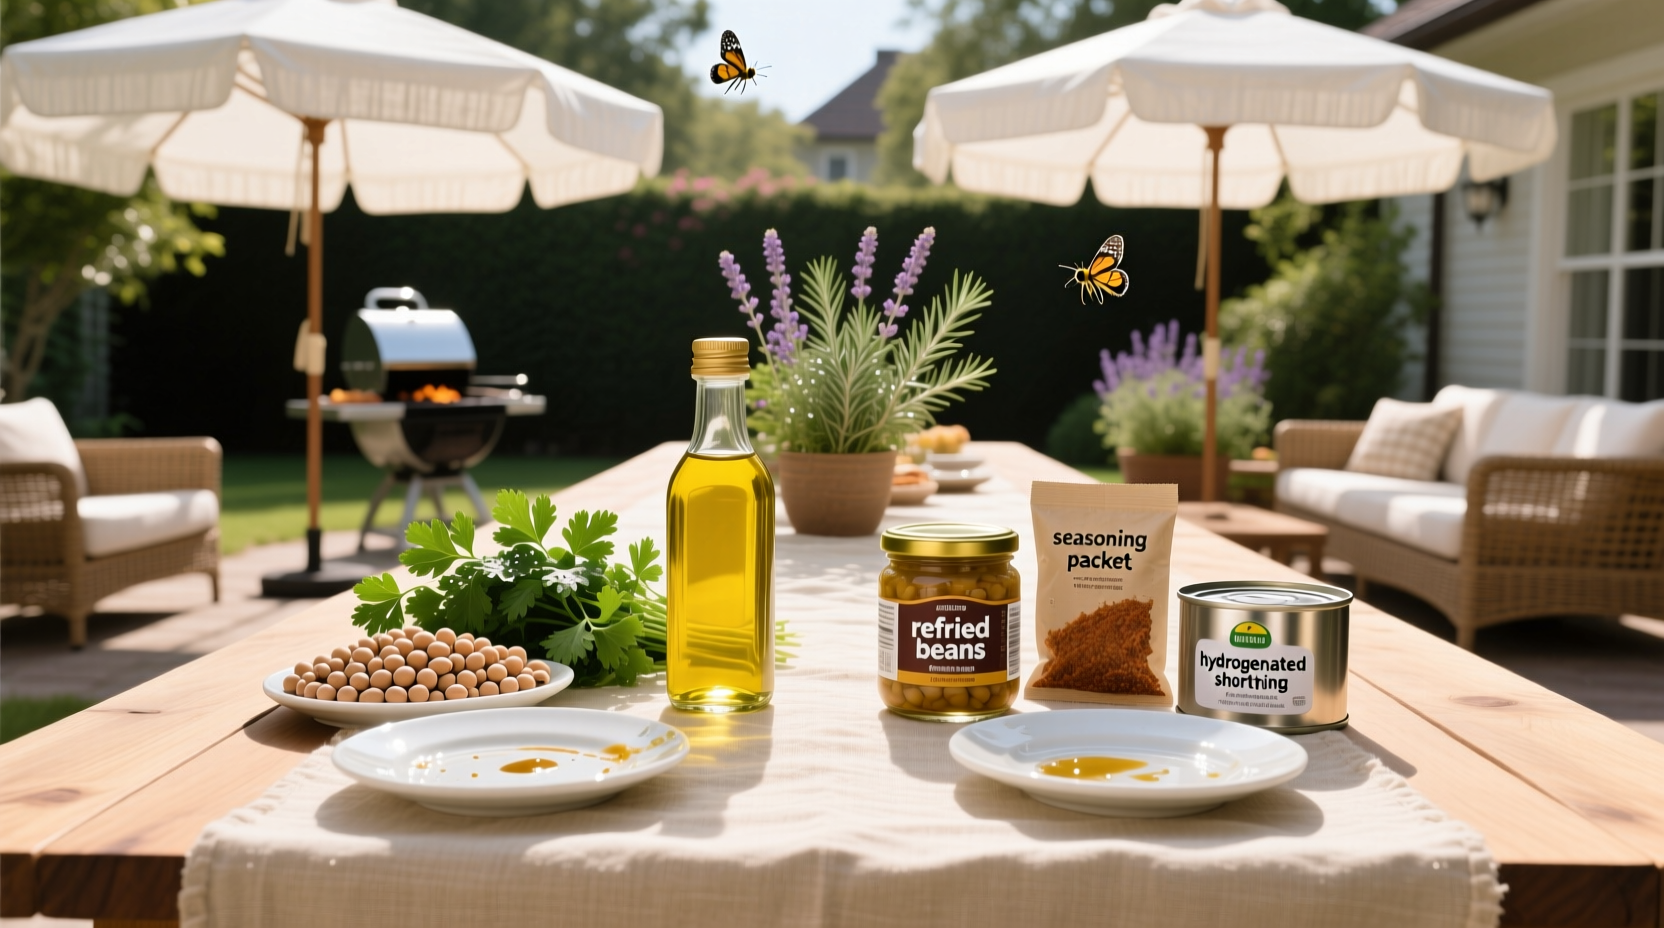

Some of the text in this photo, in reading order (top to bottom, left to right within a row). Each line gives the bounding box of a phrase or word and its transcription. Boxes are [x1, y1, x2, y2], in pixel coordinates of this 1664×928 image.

[1053, 529, 1147, 552] seasoning
[1067, 550, 1132, 572] packet
[911, 615, 990, 639] refried
[916, 637, 986, 660] beans
[1200, 650, 1306, 673] hydrogenated
